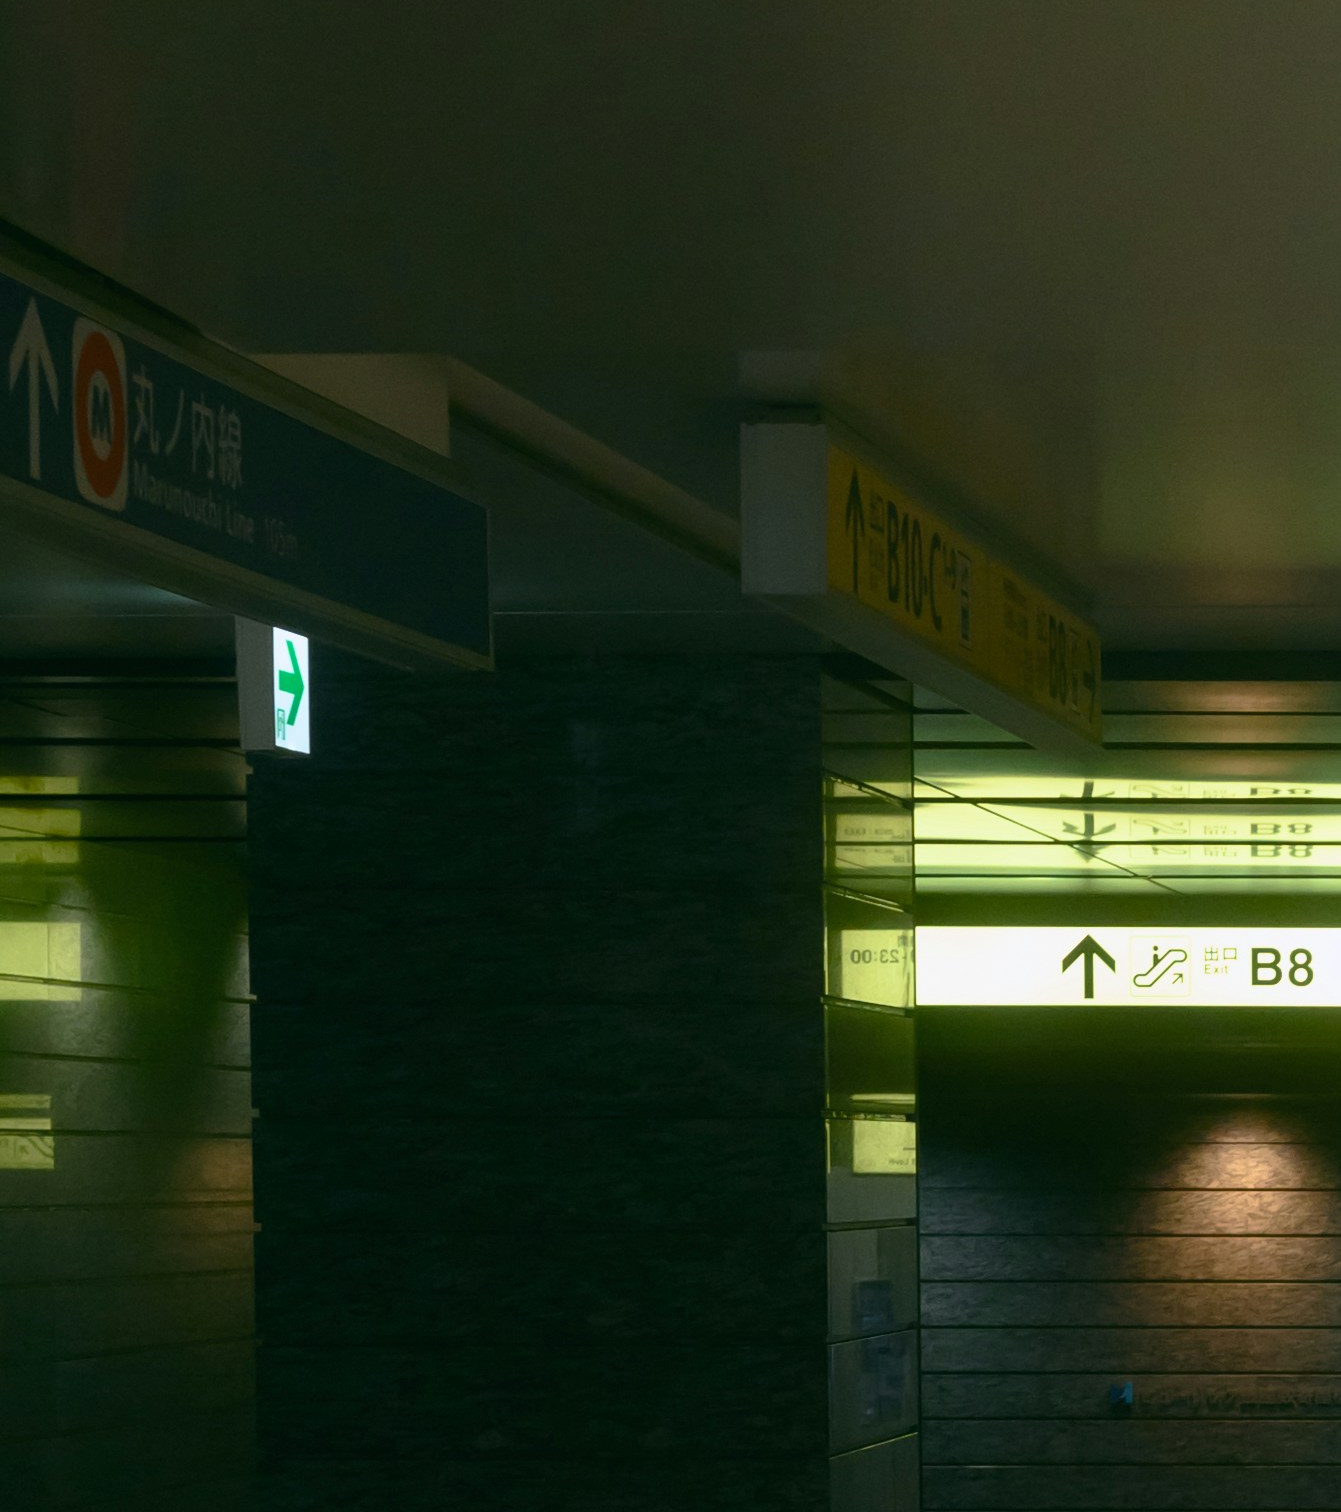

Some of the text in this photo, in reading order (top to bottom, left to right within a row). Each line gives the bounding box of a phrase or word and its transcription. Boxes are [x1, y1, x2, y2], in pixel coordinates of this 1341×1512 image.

[1204, 947, 1237, 961] 出口
[1204, 964, 1229, 974] Exit
[1251, 947, 1314, 987] B8
